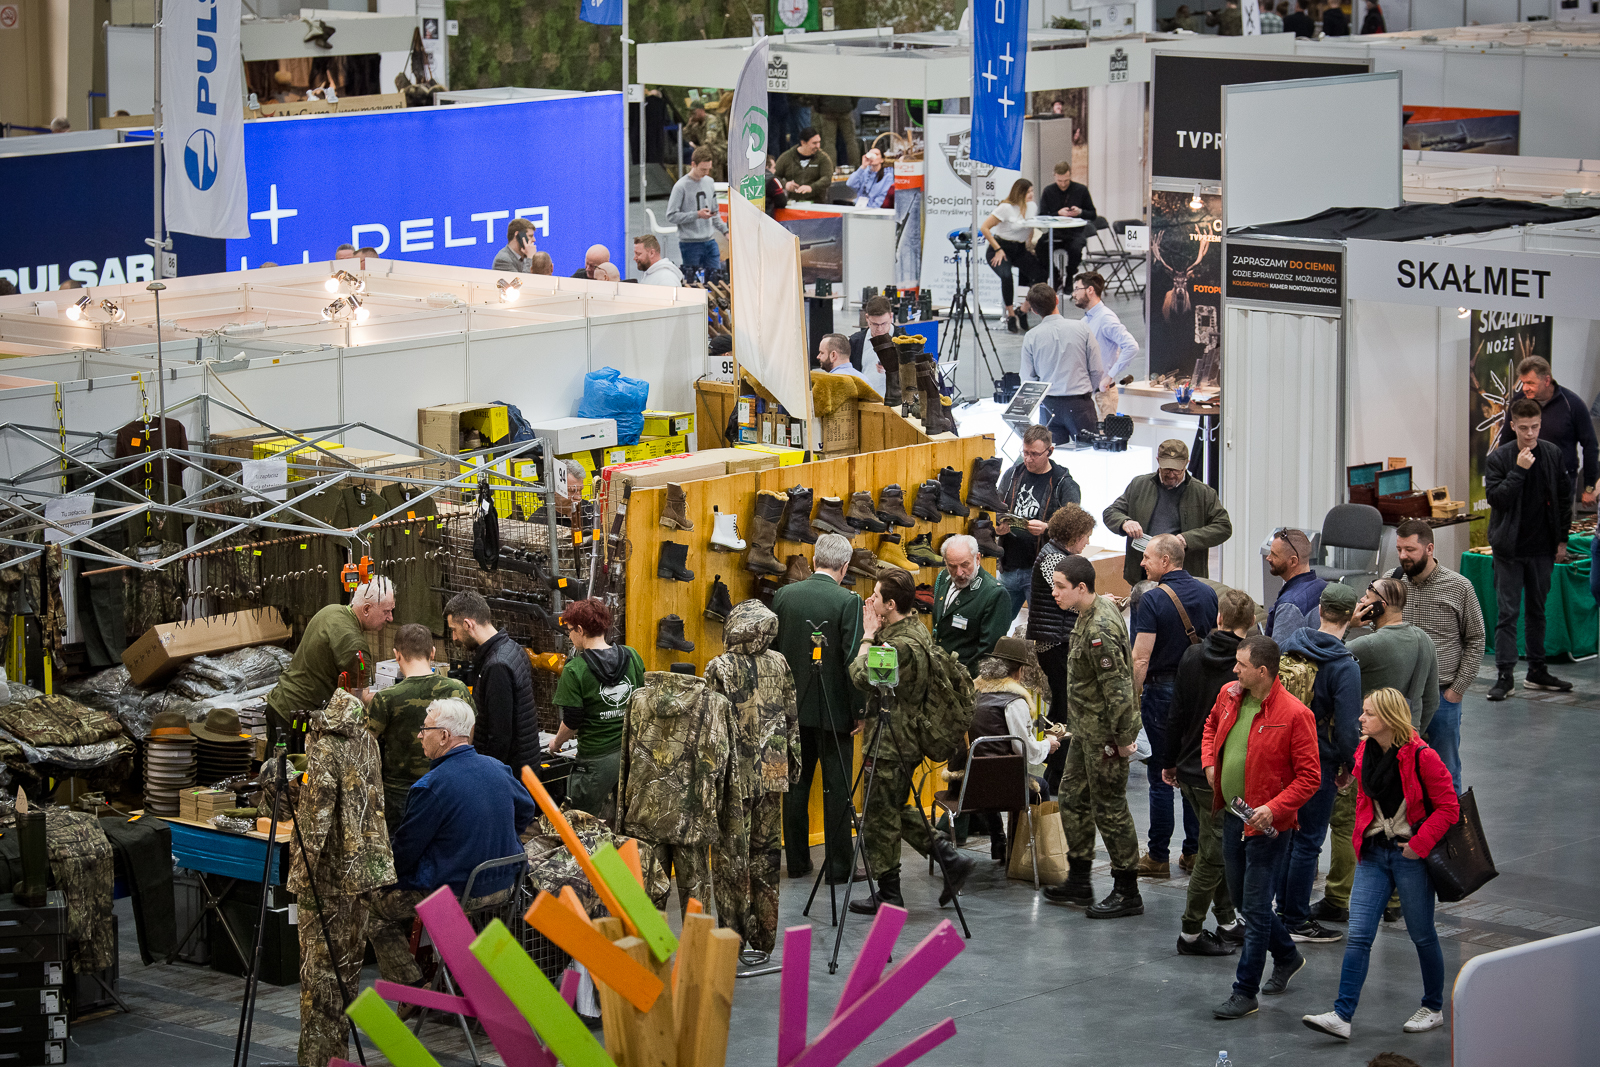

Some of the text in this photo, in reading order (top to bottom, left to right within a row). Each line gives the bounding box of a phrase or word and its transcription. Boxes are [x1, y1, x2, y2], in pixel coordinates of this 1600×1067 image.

[768, 68, 788, 78] DARZ
[1177, 131, 1222, 150] TVPR
[986, 181, 995, 190] 86
[927, 195, 980, 206] Specjaln
[940, 208, 973, 217] myśliwyc
[352, 205, 549, 255] DELTA
[1127, 230, 1137, 240] 84
[1189, 233, 1222, 243] TVPRZEM
[1232, 255, 1336, 273] ZAPRASZAMY DO CIEMNI,
[1232, 269, 1336, 284] GDZIE SPRAWDZISZ MOŻLIWOŚCI
[1397, 259, 1551, 299] SKAŁMET
[1232, 280, 1269, 288] KOLOROWYCH
[1486, 335, 1515, 354] NOŻE
[722, 361, 733, 374] 95
[559, 467, 566, 484] 94
